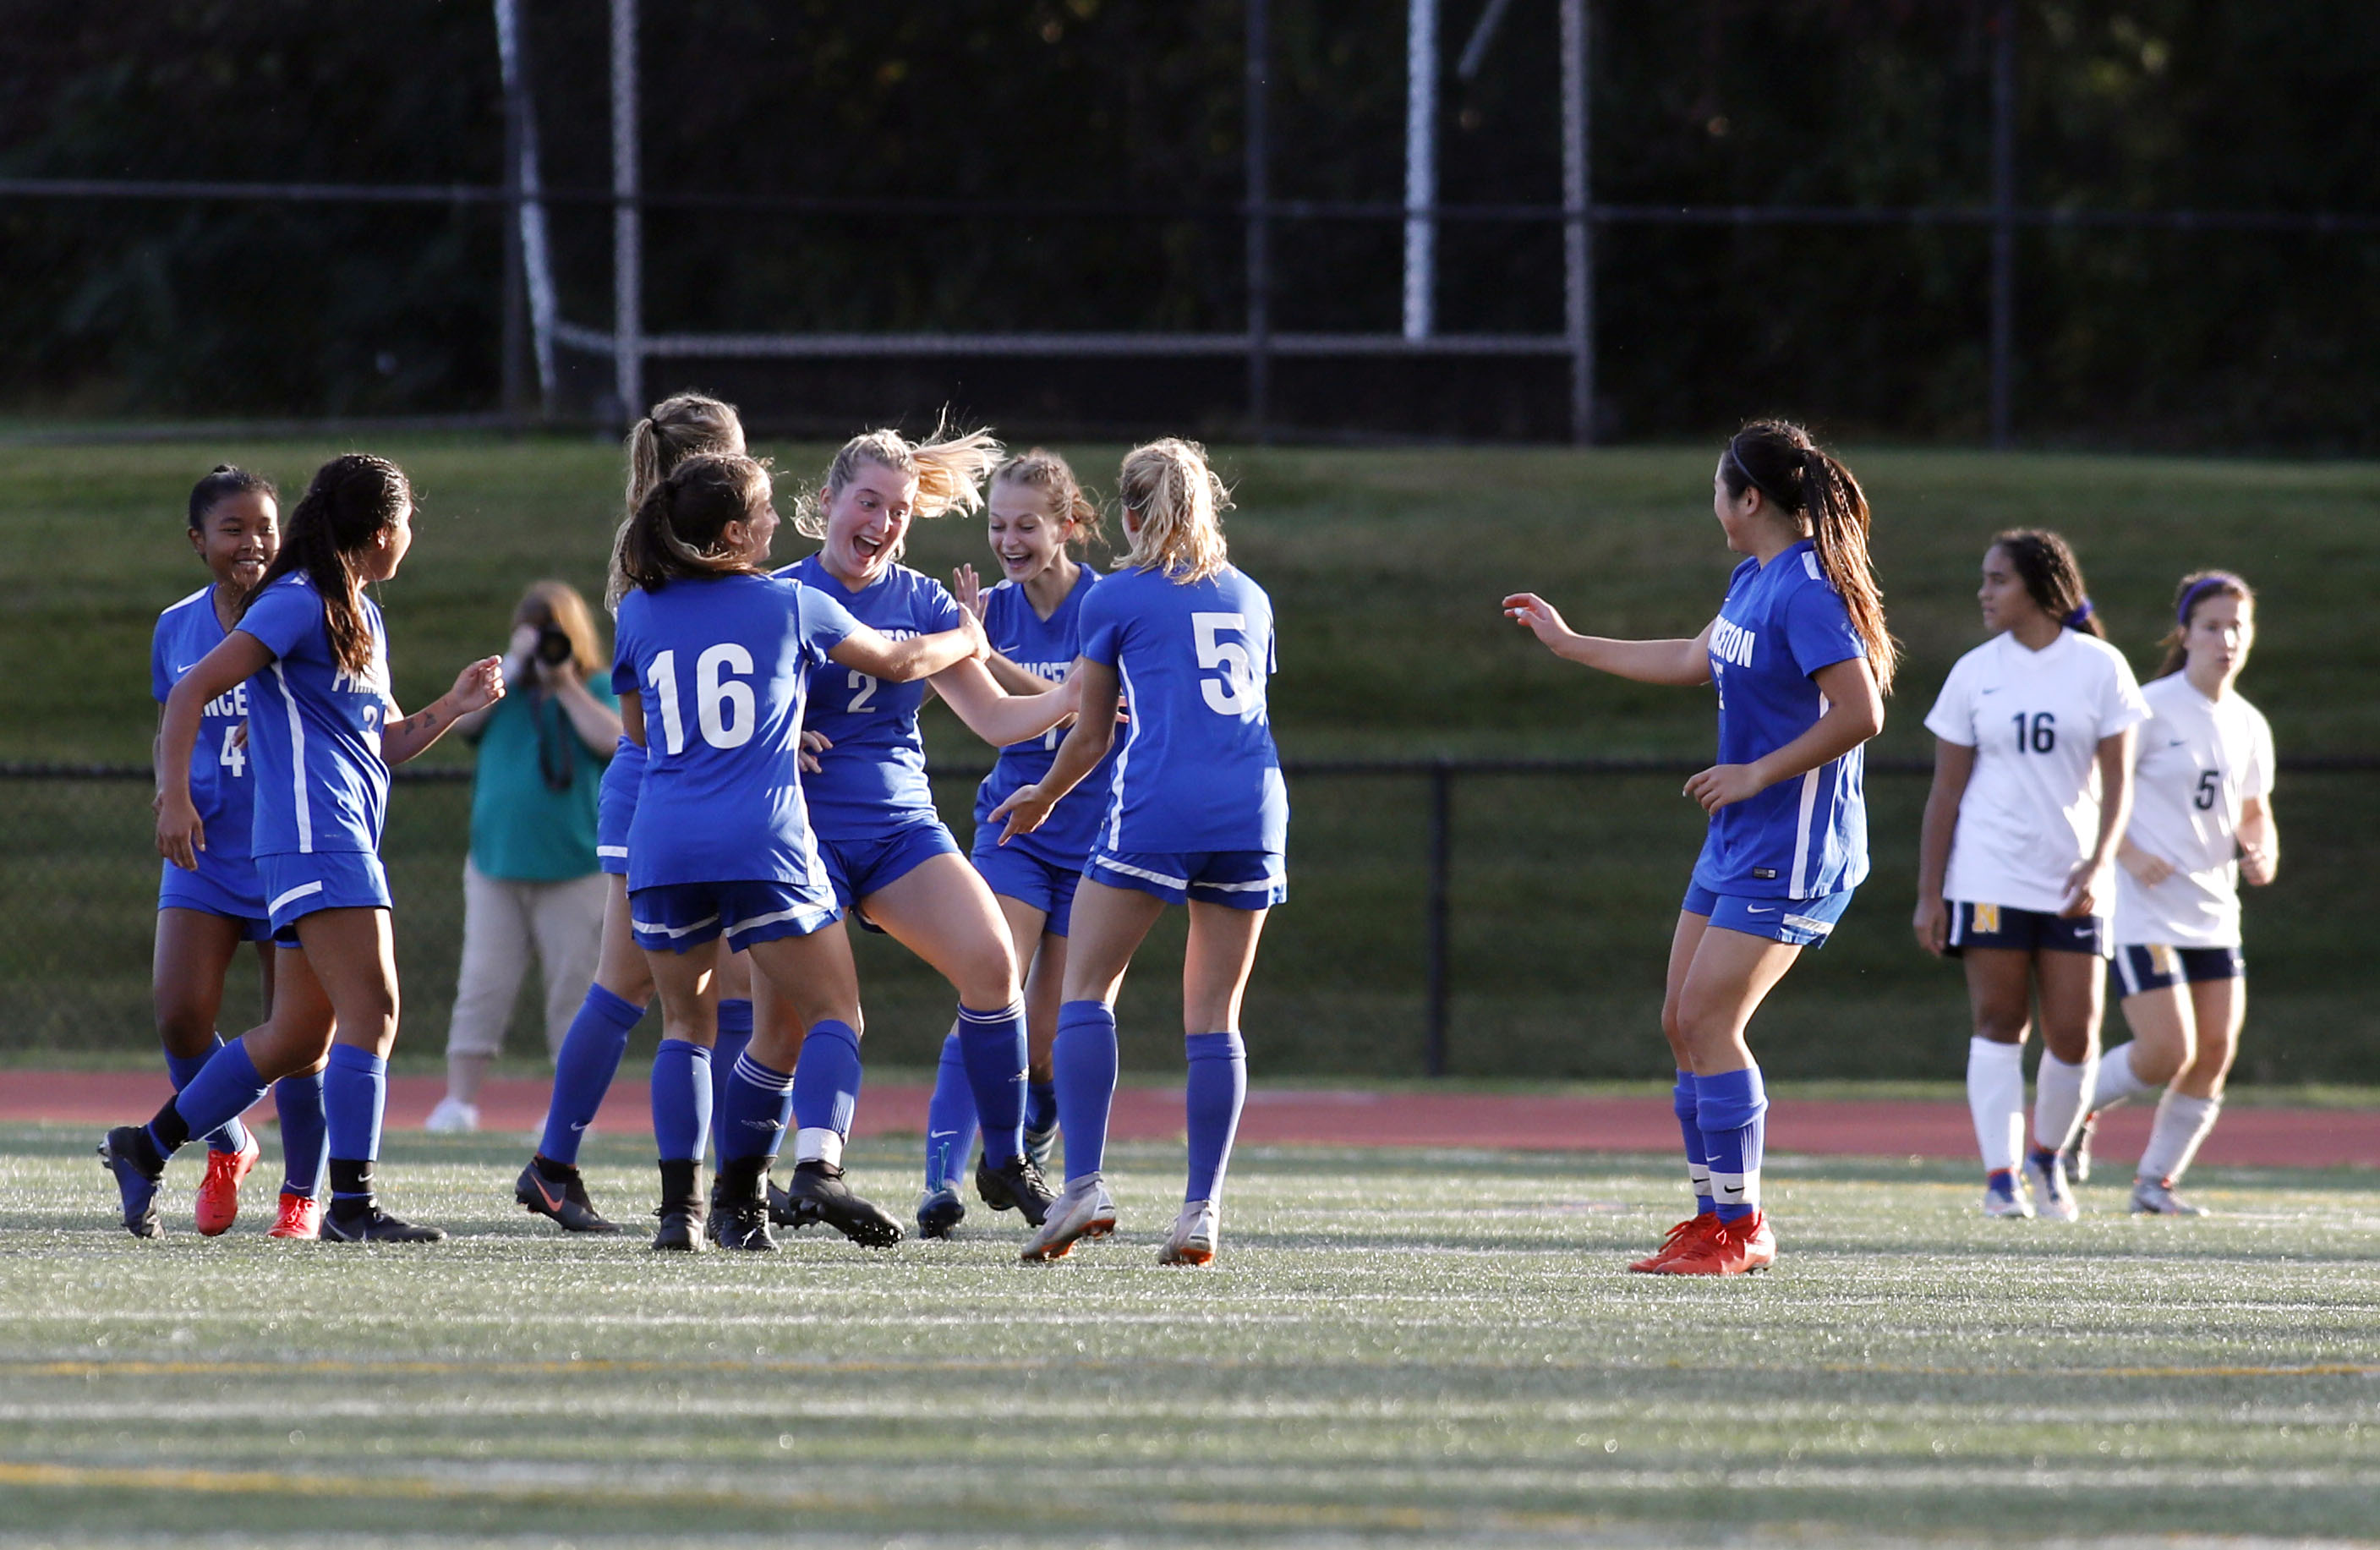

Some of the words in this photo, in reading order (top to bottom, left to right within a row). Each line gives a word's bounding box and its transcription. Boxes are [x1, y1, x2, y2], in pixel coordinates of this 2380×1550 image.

[1190, 611, 1254, 715] 5
[200, 681, 249, 717] NCE
[647, 642, 756, 756] 16
[847, 669, 878, 714] 2
[219, 725, 246, 777] 4
[2012, 711, 2056, 753] 16
[2193, 770, 2219, 810] 5
